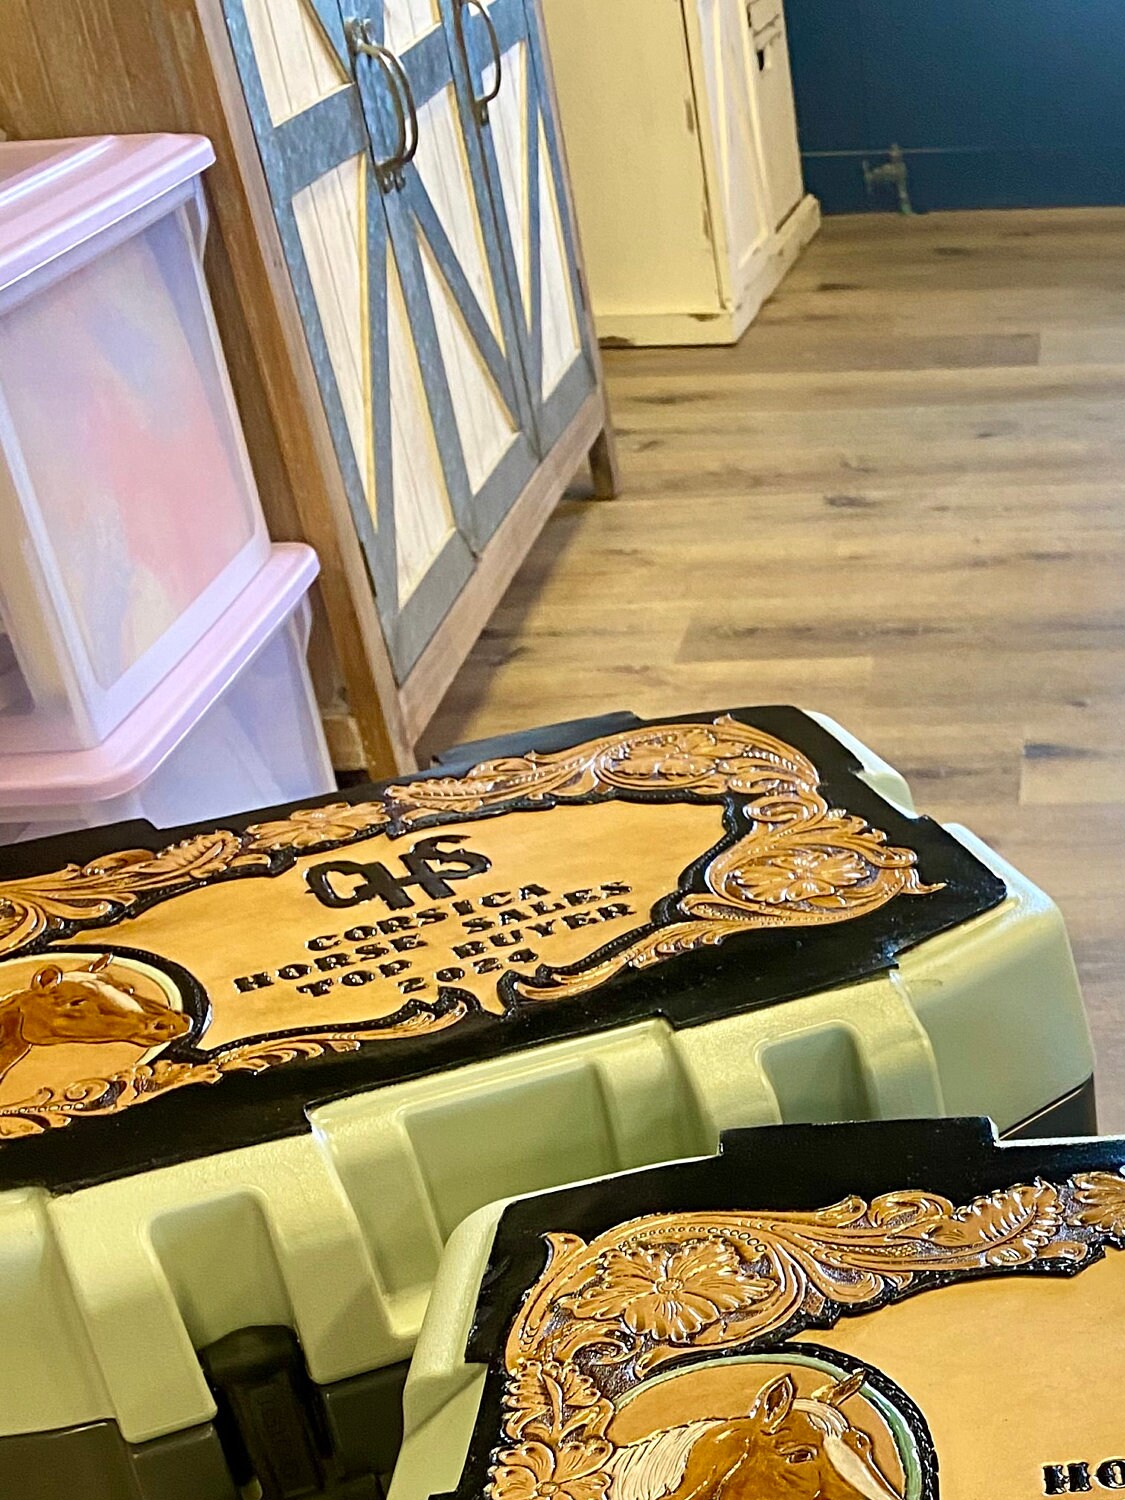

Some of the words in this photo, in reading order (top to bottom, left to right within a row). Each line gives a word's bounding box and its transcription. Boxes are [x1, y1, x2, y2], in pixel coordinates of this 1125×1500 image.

[234, 933, 428, 994] HORSE
[462, 881, 632, 933] SALES
[297, 958, 412, 997] TOP
[453, 902, 636, 959] BUYER
[305, 883, 551, 951] CORSICA
[398, 948, 538, 994] 2024
